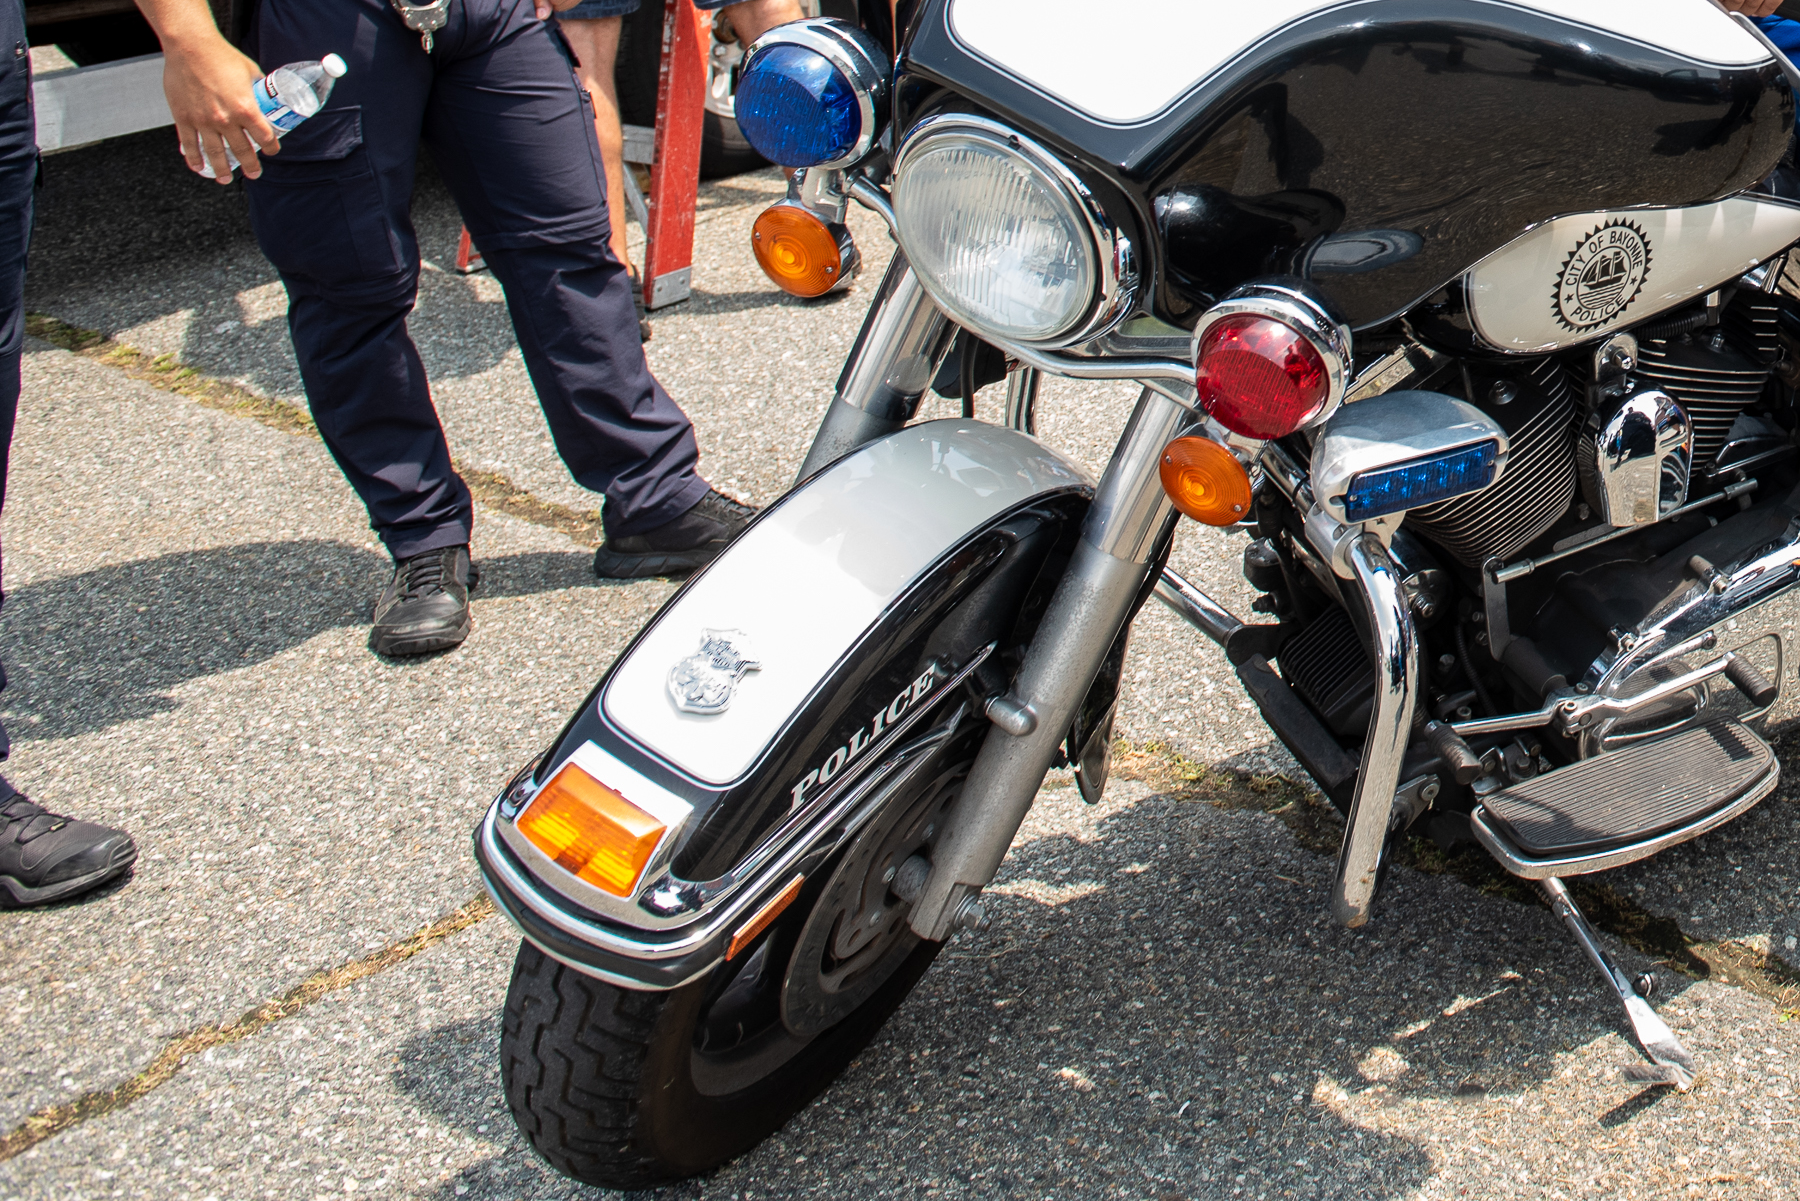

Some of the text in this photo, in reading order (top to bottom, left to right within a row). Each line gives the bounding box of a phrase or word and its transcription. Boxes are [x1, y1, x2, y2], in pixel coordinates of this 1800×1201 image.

[1565, 230, 1643, 286] CITY OF BAYONNE
[1570, 294, 1626, 321] POLICE
[787, 662, 936, 817] POLICE
